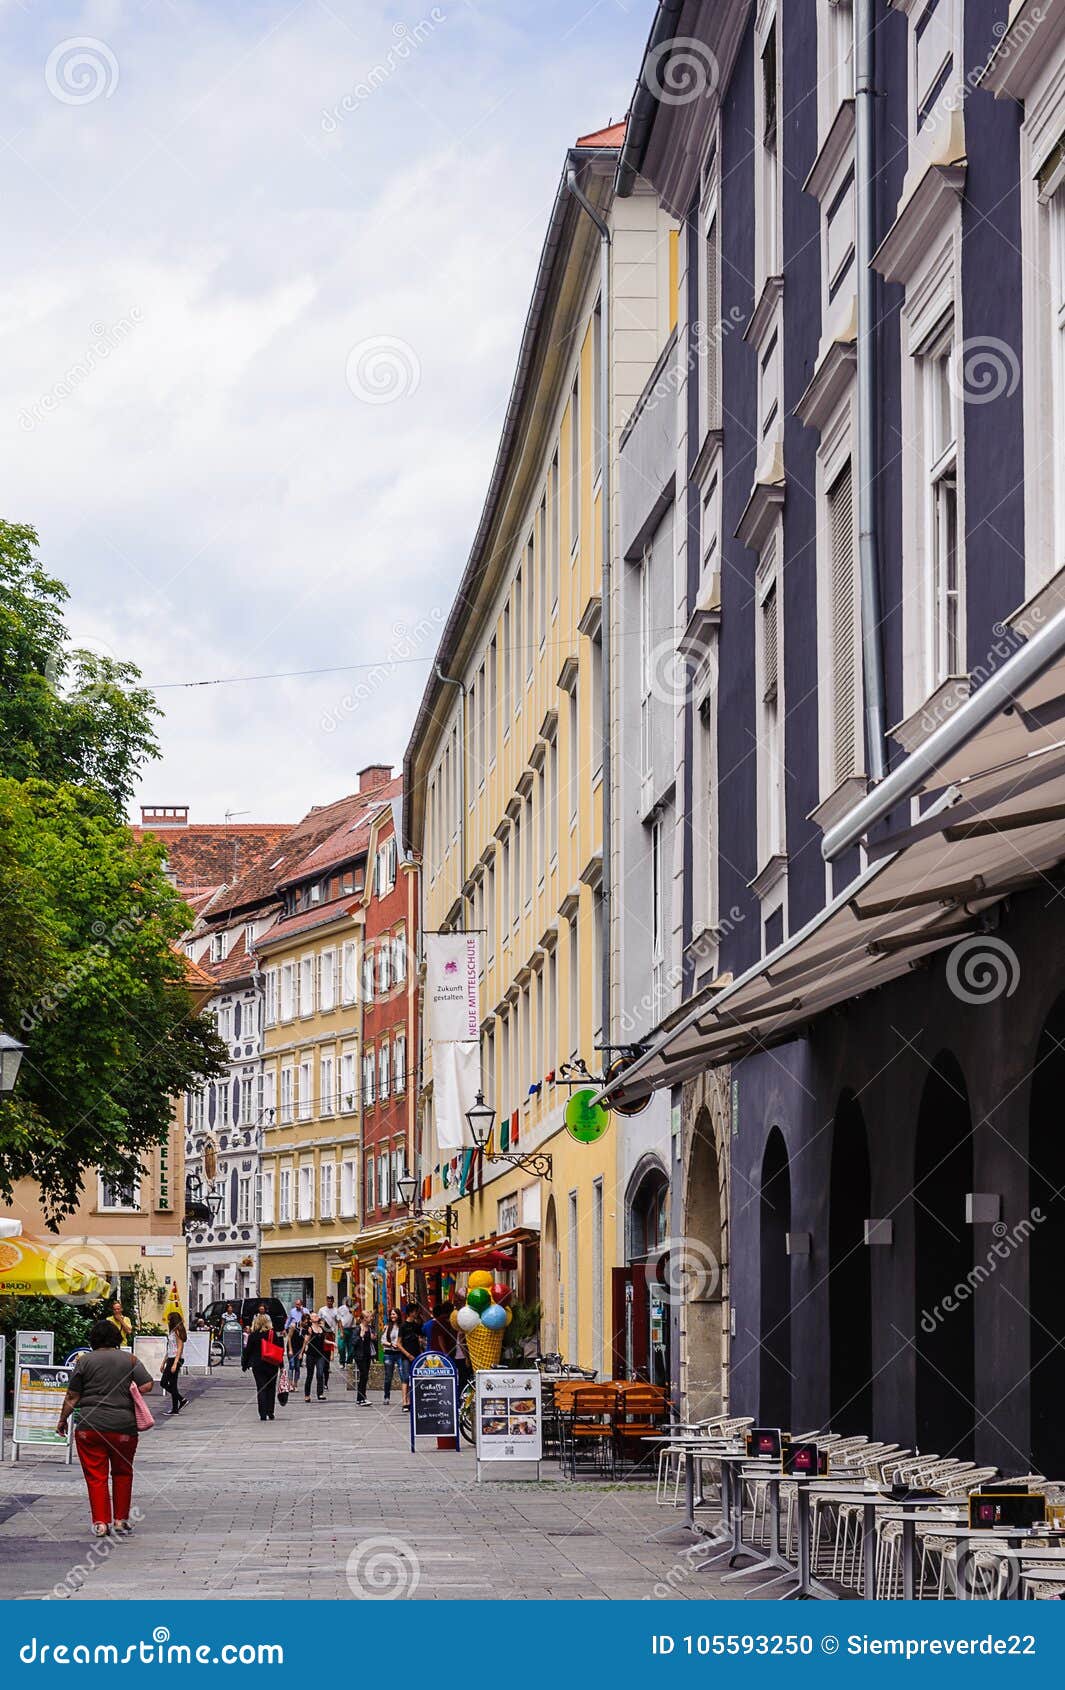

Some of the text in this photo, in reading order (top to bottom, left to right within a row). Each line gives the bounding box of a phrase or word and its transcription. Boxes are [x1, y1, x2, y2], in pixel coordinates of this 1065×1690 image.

[433, 993, 464, 1002] gestalten
[467, 939, 477, 1036] NEUE MITTELSCHULE
